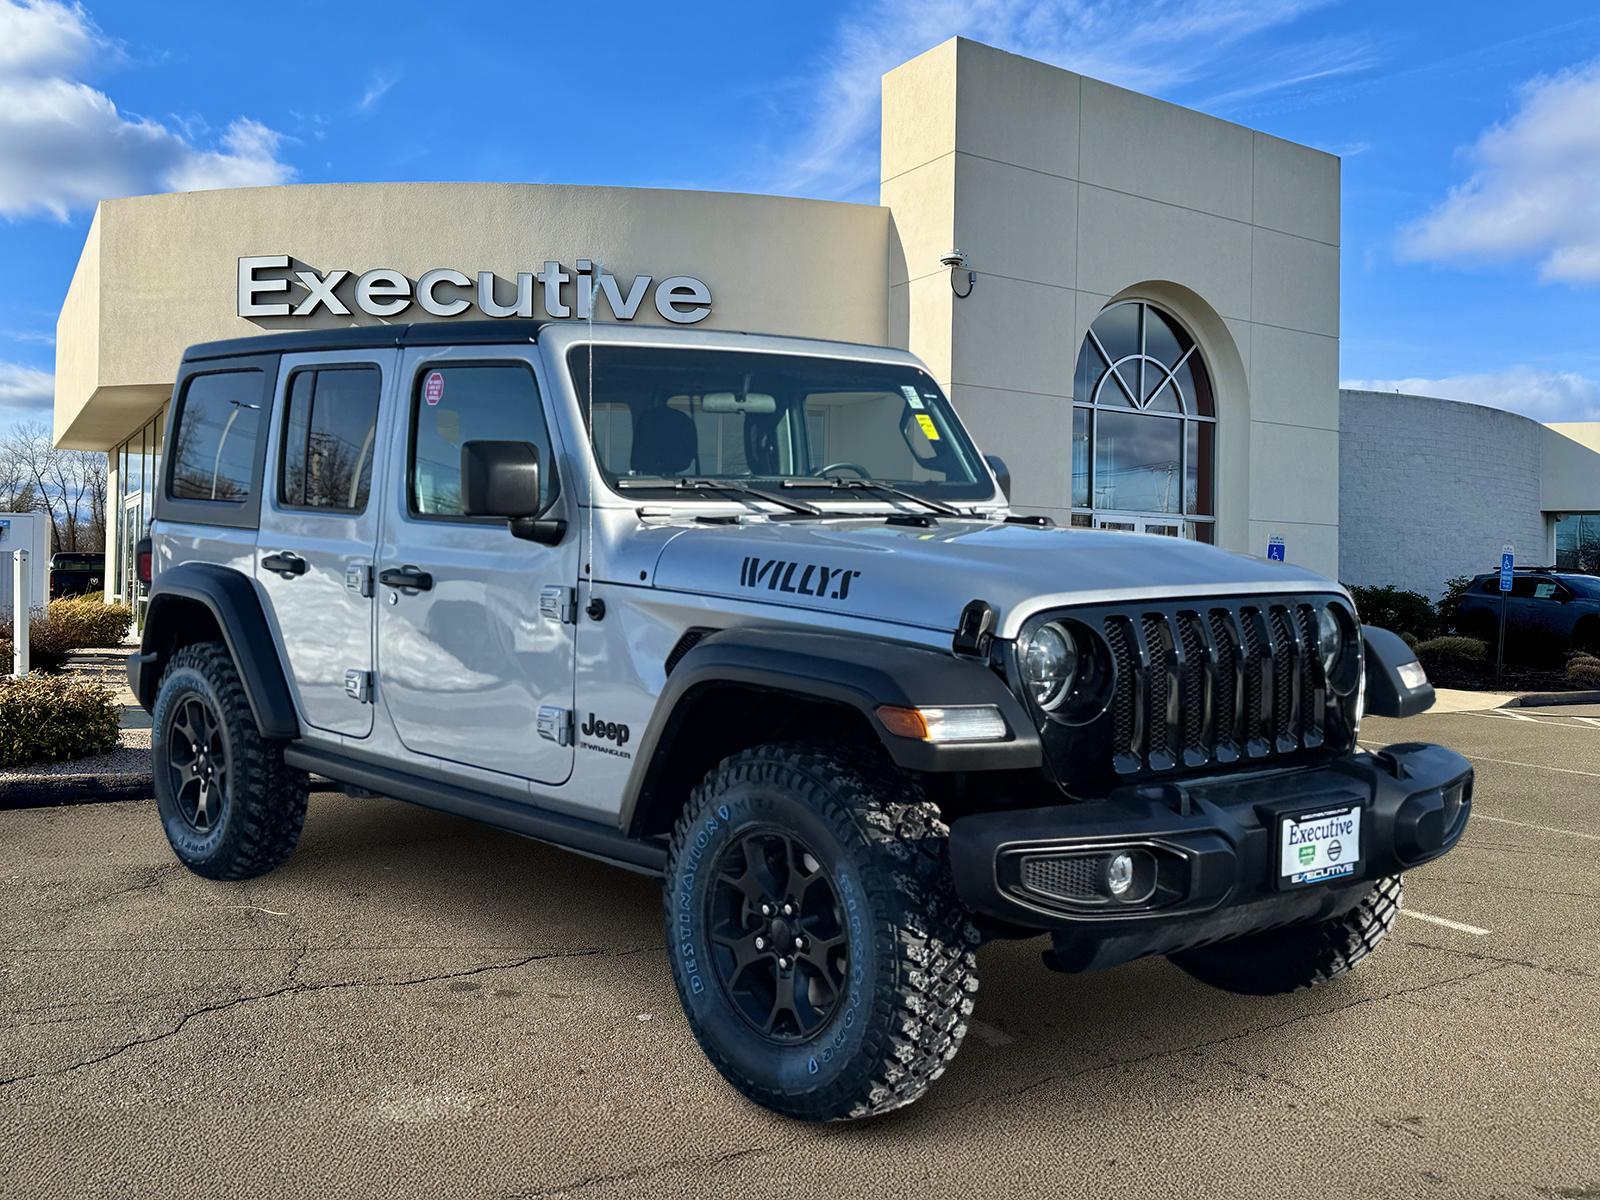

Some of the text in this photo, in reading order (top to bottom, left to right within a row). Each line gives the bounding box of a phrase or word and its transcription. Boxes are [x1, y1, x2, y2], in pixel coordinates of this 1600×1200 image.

[237, 254, 713, 324] Executive
[740, 556, 862, 601] WILLYS
[581, 712, 630, 747] Jeep
[1288, 817, 1354, 846] Executive
[1291, 862, 1355, 884] EXECUTIVE
[680, 819, 719, 994] DESTINATION
